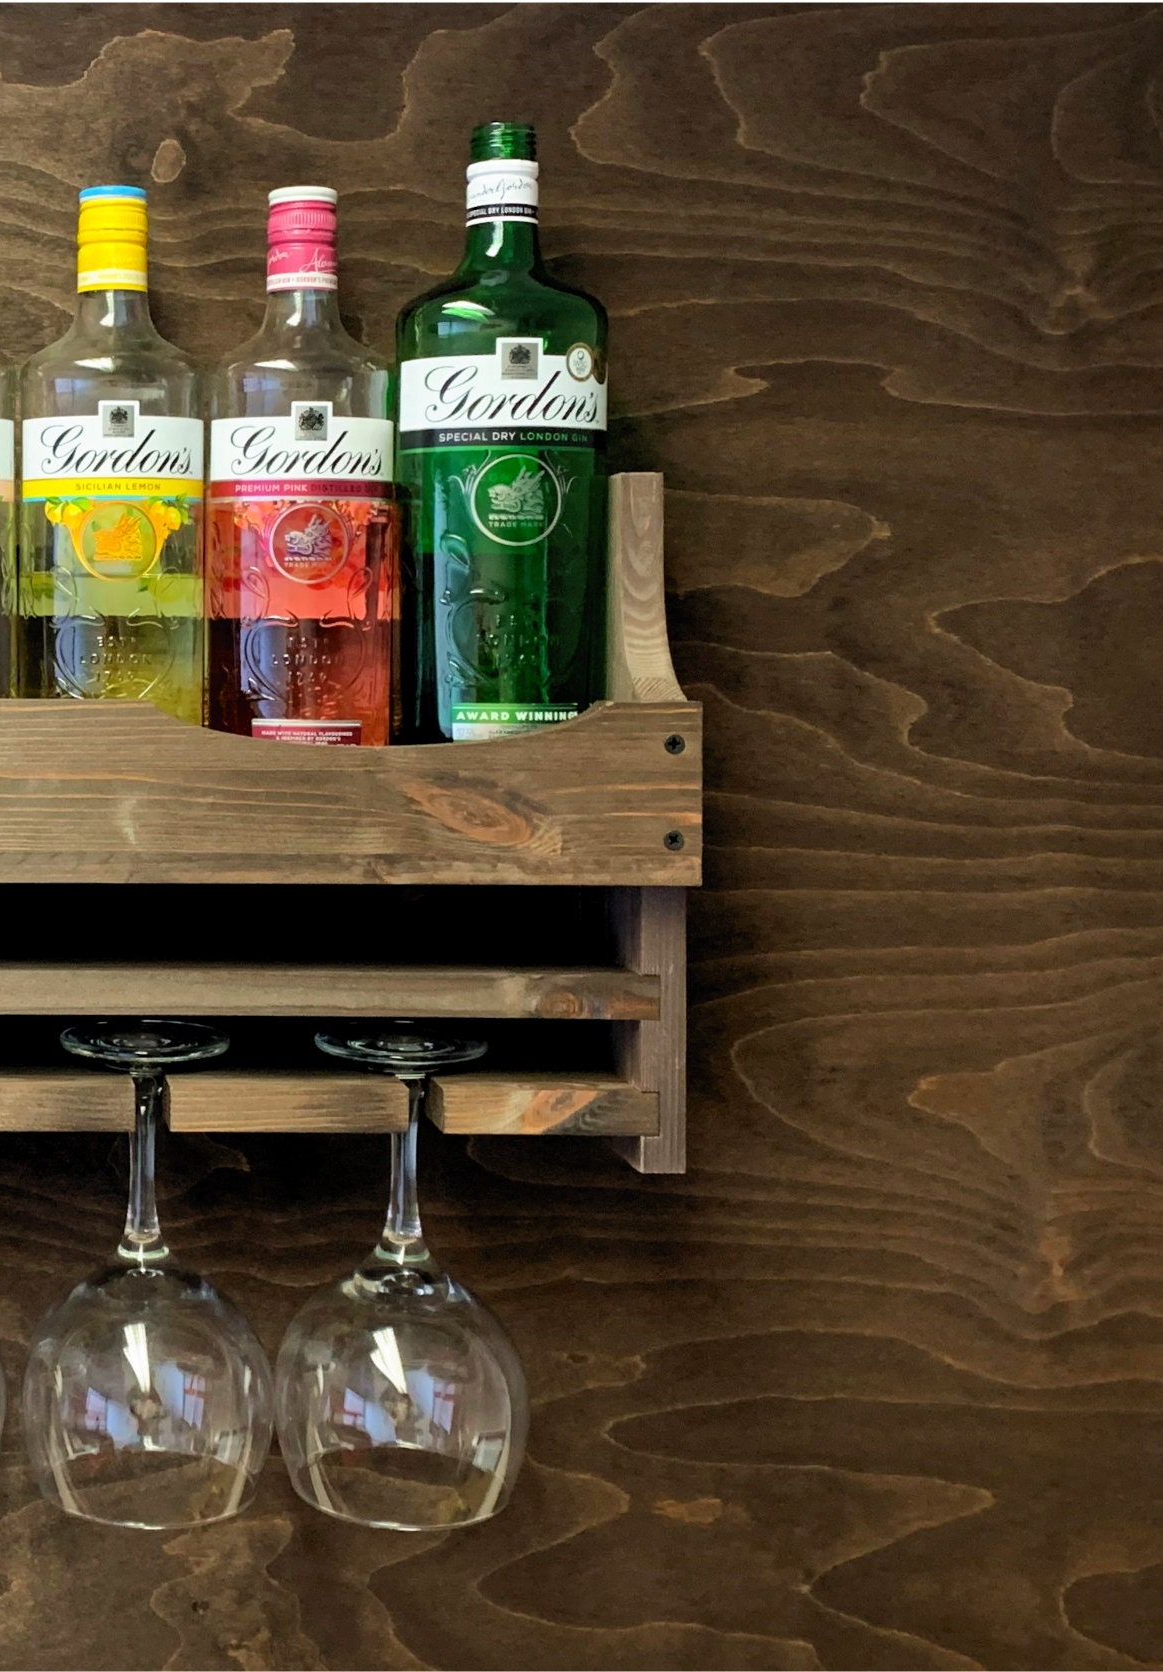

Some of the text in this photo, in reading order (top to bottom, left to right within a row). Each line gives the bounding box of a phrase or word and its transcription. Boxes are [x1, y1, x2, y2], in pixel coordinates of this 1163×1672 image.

[500, 206, 523, 214] LONDON
[425, 365, 598, 424] Gordon's
[438, 431, 588, 443] SPECIAL DRY LONDON GIN
[40, 424, 192, 475] Gordon's
[230, 425, 383, 477] Gordon's
[75, 483, 161, 491] SICILIAN LEMON
[235, 484, 280, 492] PREMIUM
[284, 484, 308, 492] PINK
[456, 711, 509, 721] AWARD
